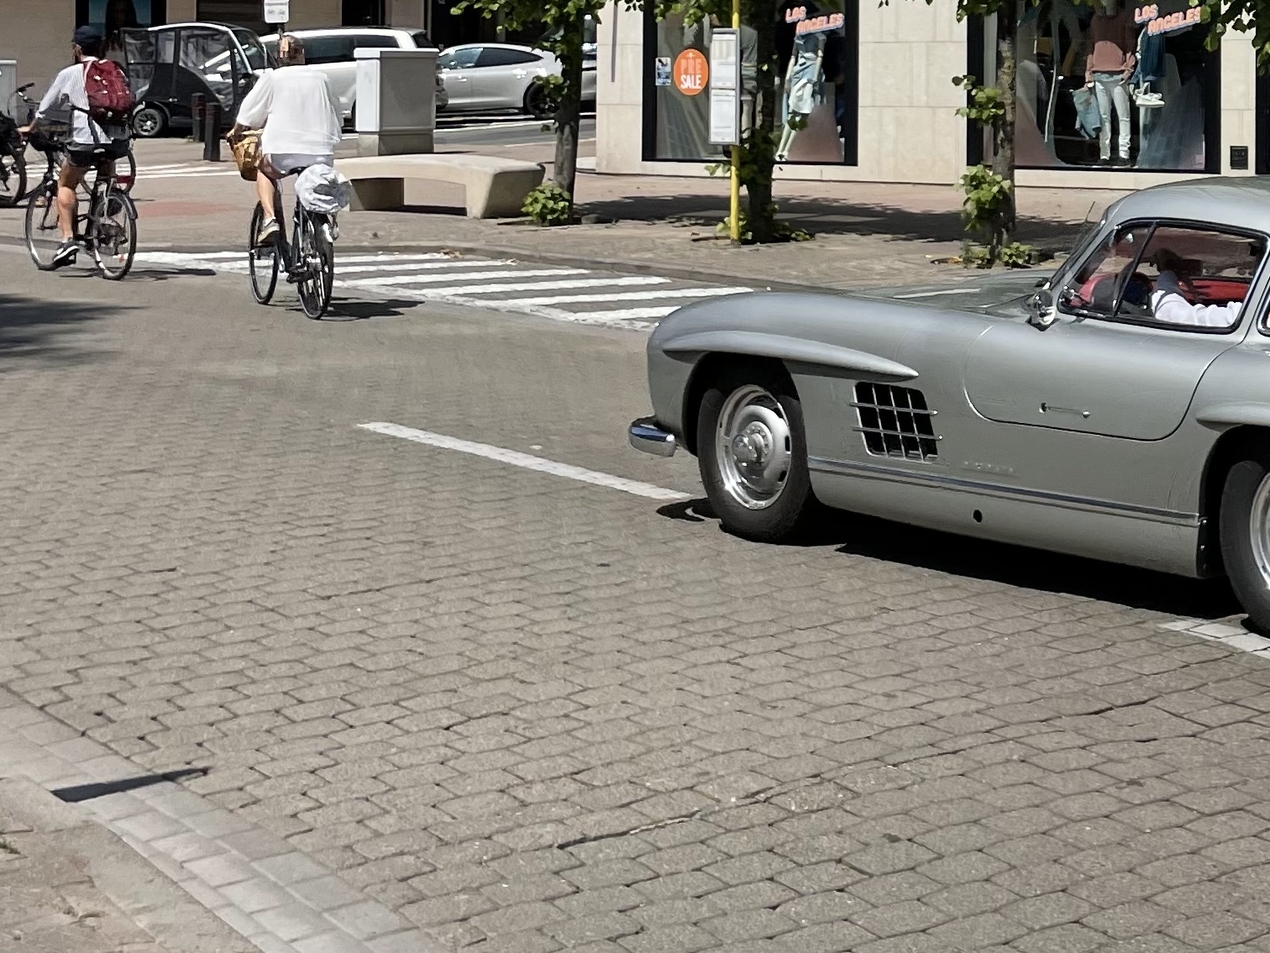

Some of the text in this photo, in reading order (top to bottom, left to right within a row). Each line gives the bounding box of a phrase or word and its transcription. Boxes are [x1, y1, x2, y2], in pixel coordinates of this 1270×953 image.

[786, 6, 807, 23] LOS
[1134, 3, 1159, 23] LOS
[797, 13, 844, 35] ANGELES
[681, 59, 702, 74] PRE
[680, 74, 702, 90] SALE
